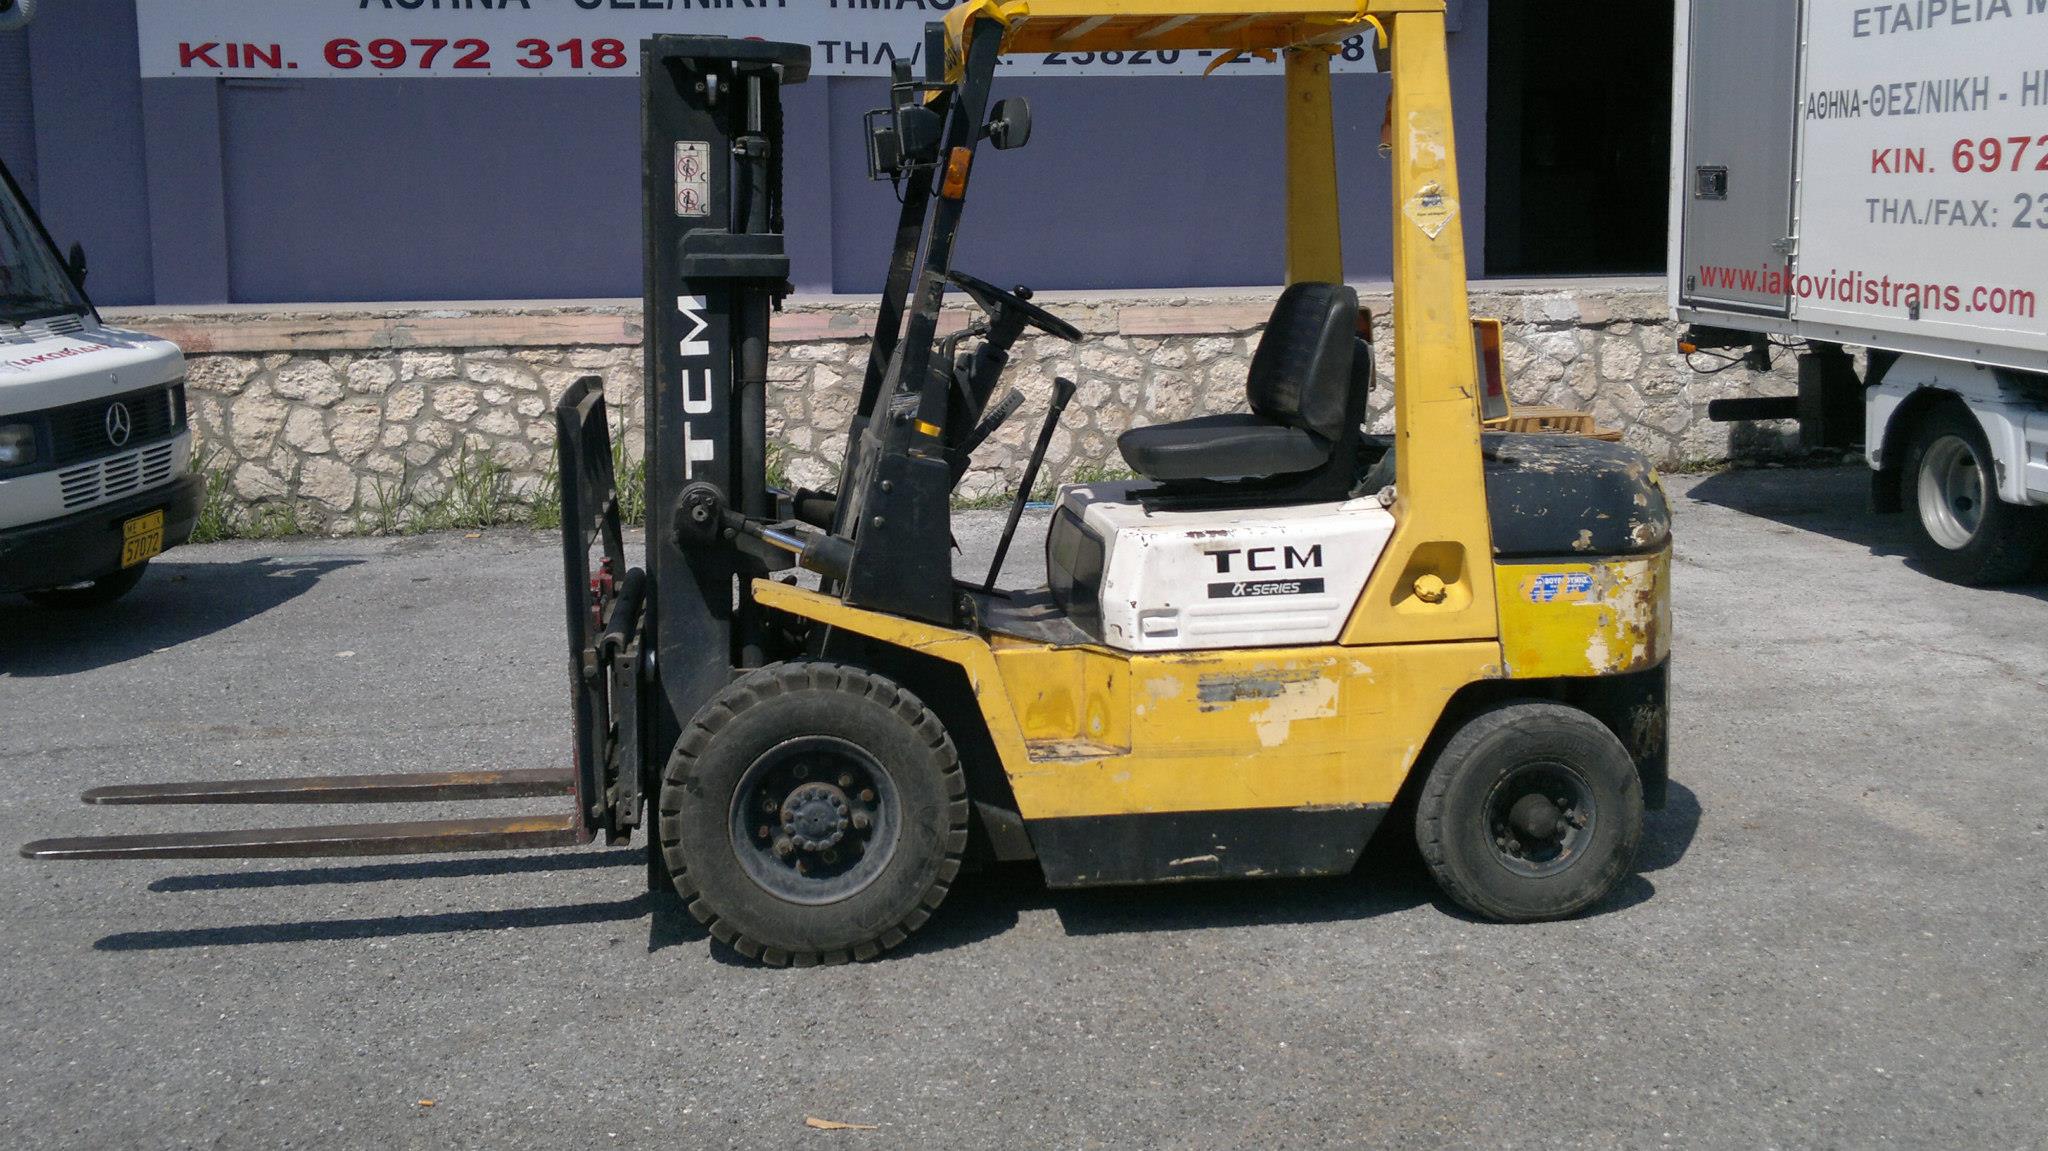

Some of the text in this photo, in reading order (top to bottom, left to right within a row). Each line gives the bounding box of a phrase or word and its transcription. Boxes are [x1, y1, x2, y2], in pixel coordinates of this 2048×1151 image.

[1853, 0, 2013, 38] ΕΤΑΙΡΕΙΑ
[180, 38, 627, 69] ΚΙΝ. 6972 318
[1806, 76, 1989, 120] ΑΘΗΝΑ-ΘΕΣ/ΝΙΚΗ
[2021, 69, 2048, 107] Η
[1871, 134, 2048, 174] ΚΙΝ. 6972
[1866, 198, 1998, 228] ΤΗΛ./FAX:
[1700, 264, 2036, 318] www.iakovidistrans.com
[677, 295, 714, 480] TCM
[1204, 544, 1322, 573] TCM
